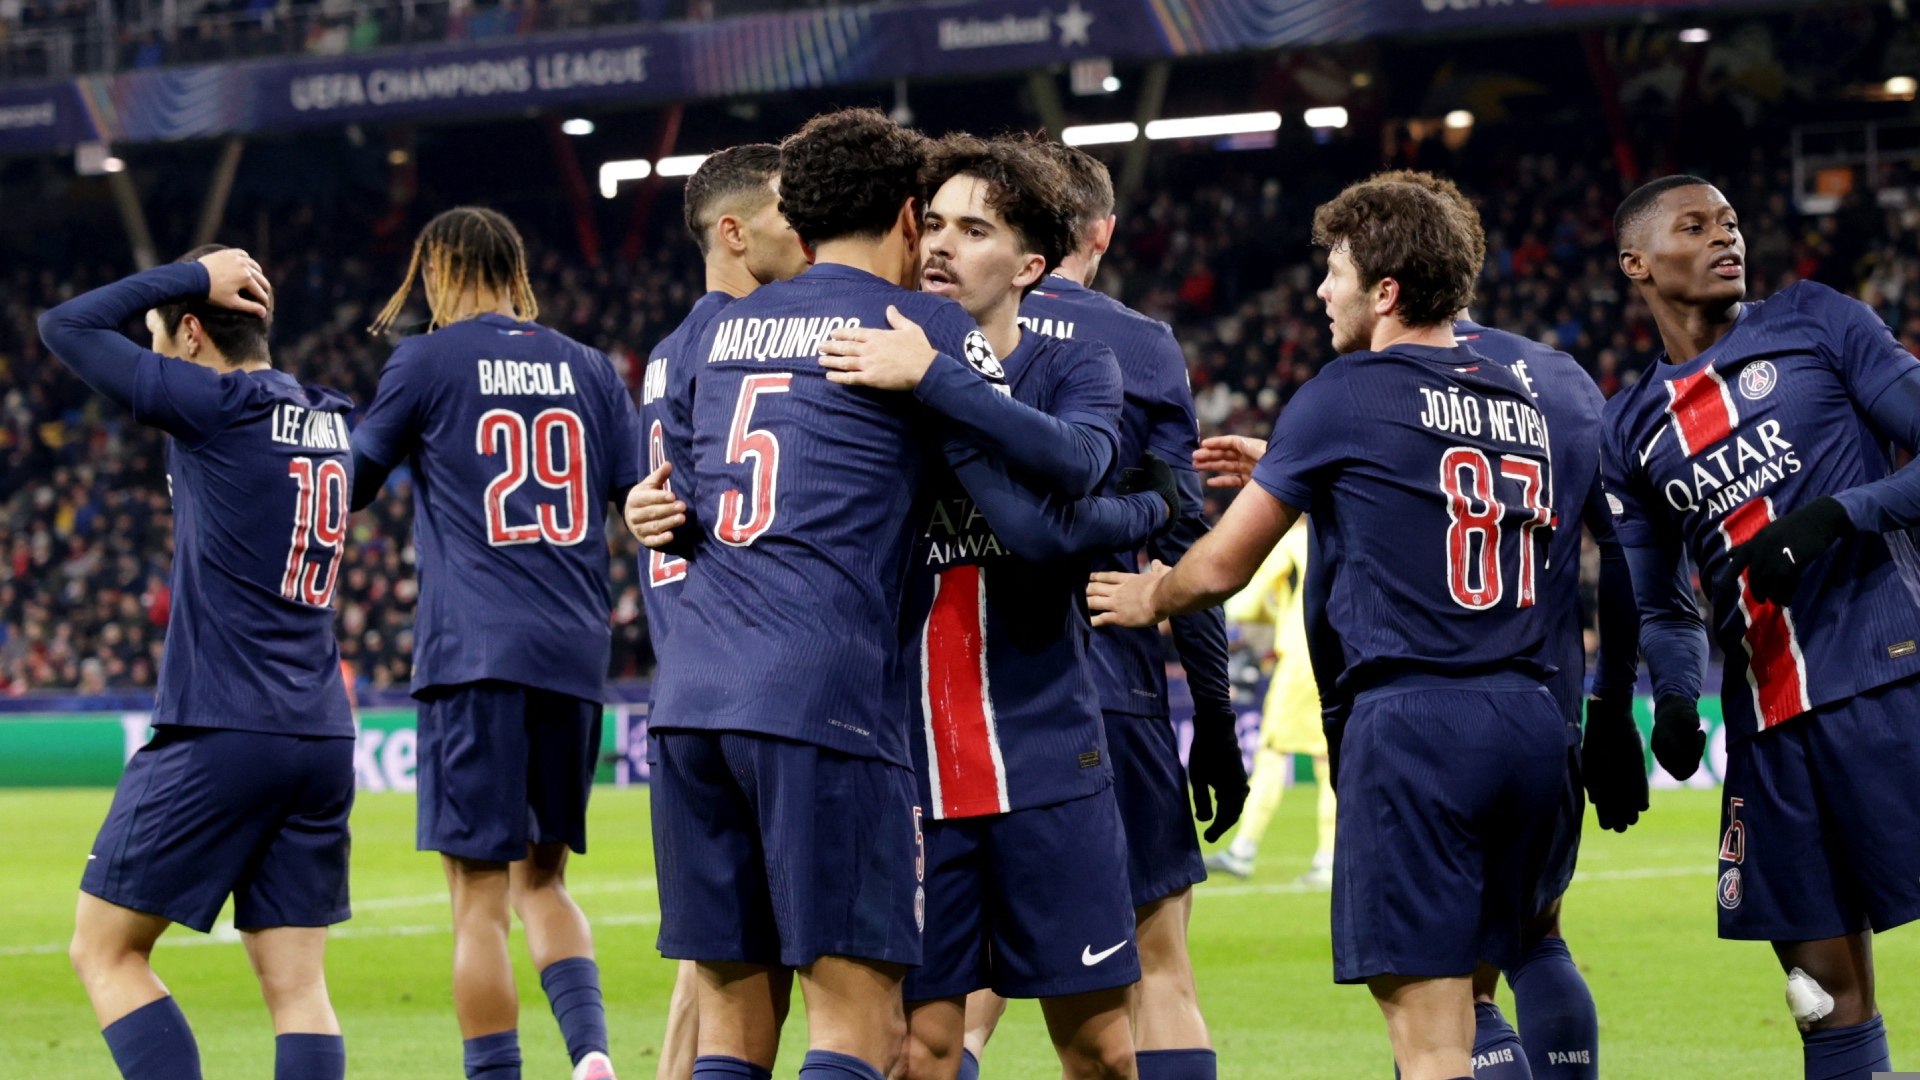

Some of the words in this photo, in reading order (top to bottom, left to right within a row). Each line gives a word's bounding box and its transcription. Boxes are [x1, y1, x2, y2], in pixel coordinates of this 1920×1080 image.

[290, 72, 366, 111] UEFA
[367, 56, 532, 105] CHAMPIONS
[536, 46, 648, 90] LEAGUE
[708, 316, 861, 364] MARQUINHO
[478, 359, 576, 396] BARCOLA
[271, 403, 305, 446] LEE
[302, 409, 338, 450] KANG
[1419, 386, 1482, 437] JOÃO
[1486, 398, 1545, 449] NEVES
[476, 408, 588, 547] 29
[714, 372, 793, 548] 5
[1665, 419, 1793, 513] QATAR
[1707, 450, 1802, 520] AIRWAYS
[281, 456, 348, 608] 19
[1439, 446, 1551, 609] 87
[1470, 1048, 1514, 1072] PARIS
[1547, 1050, 1590, 1066] PARIS
